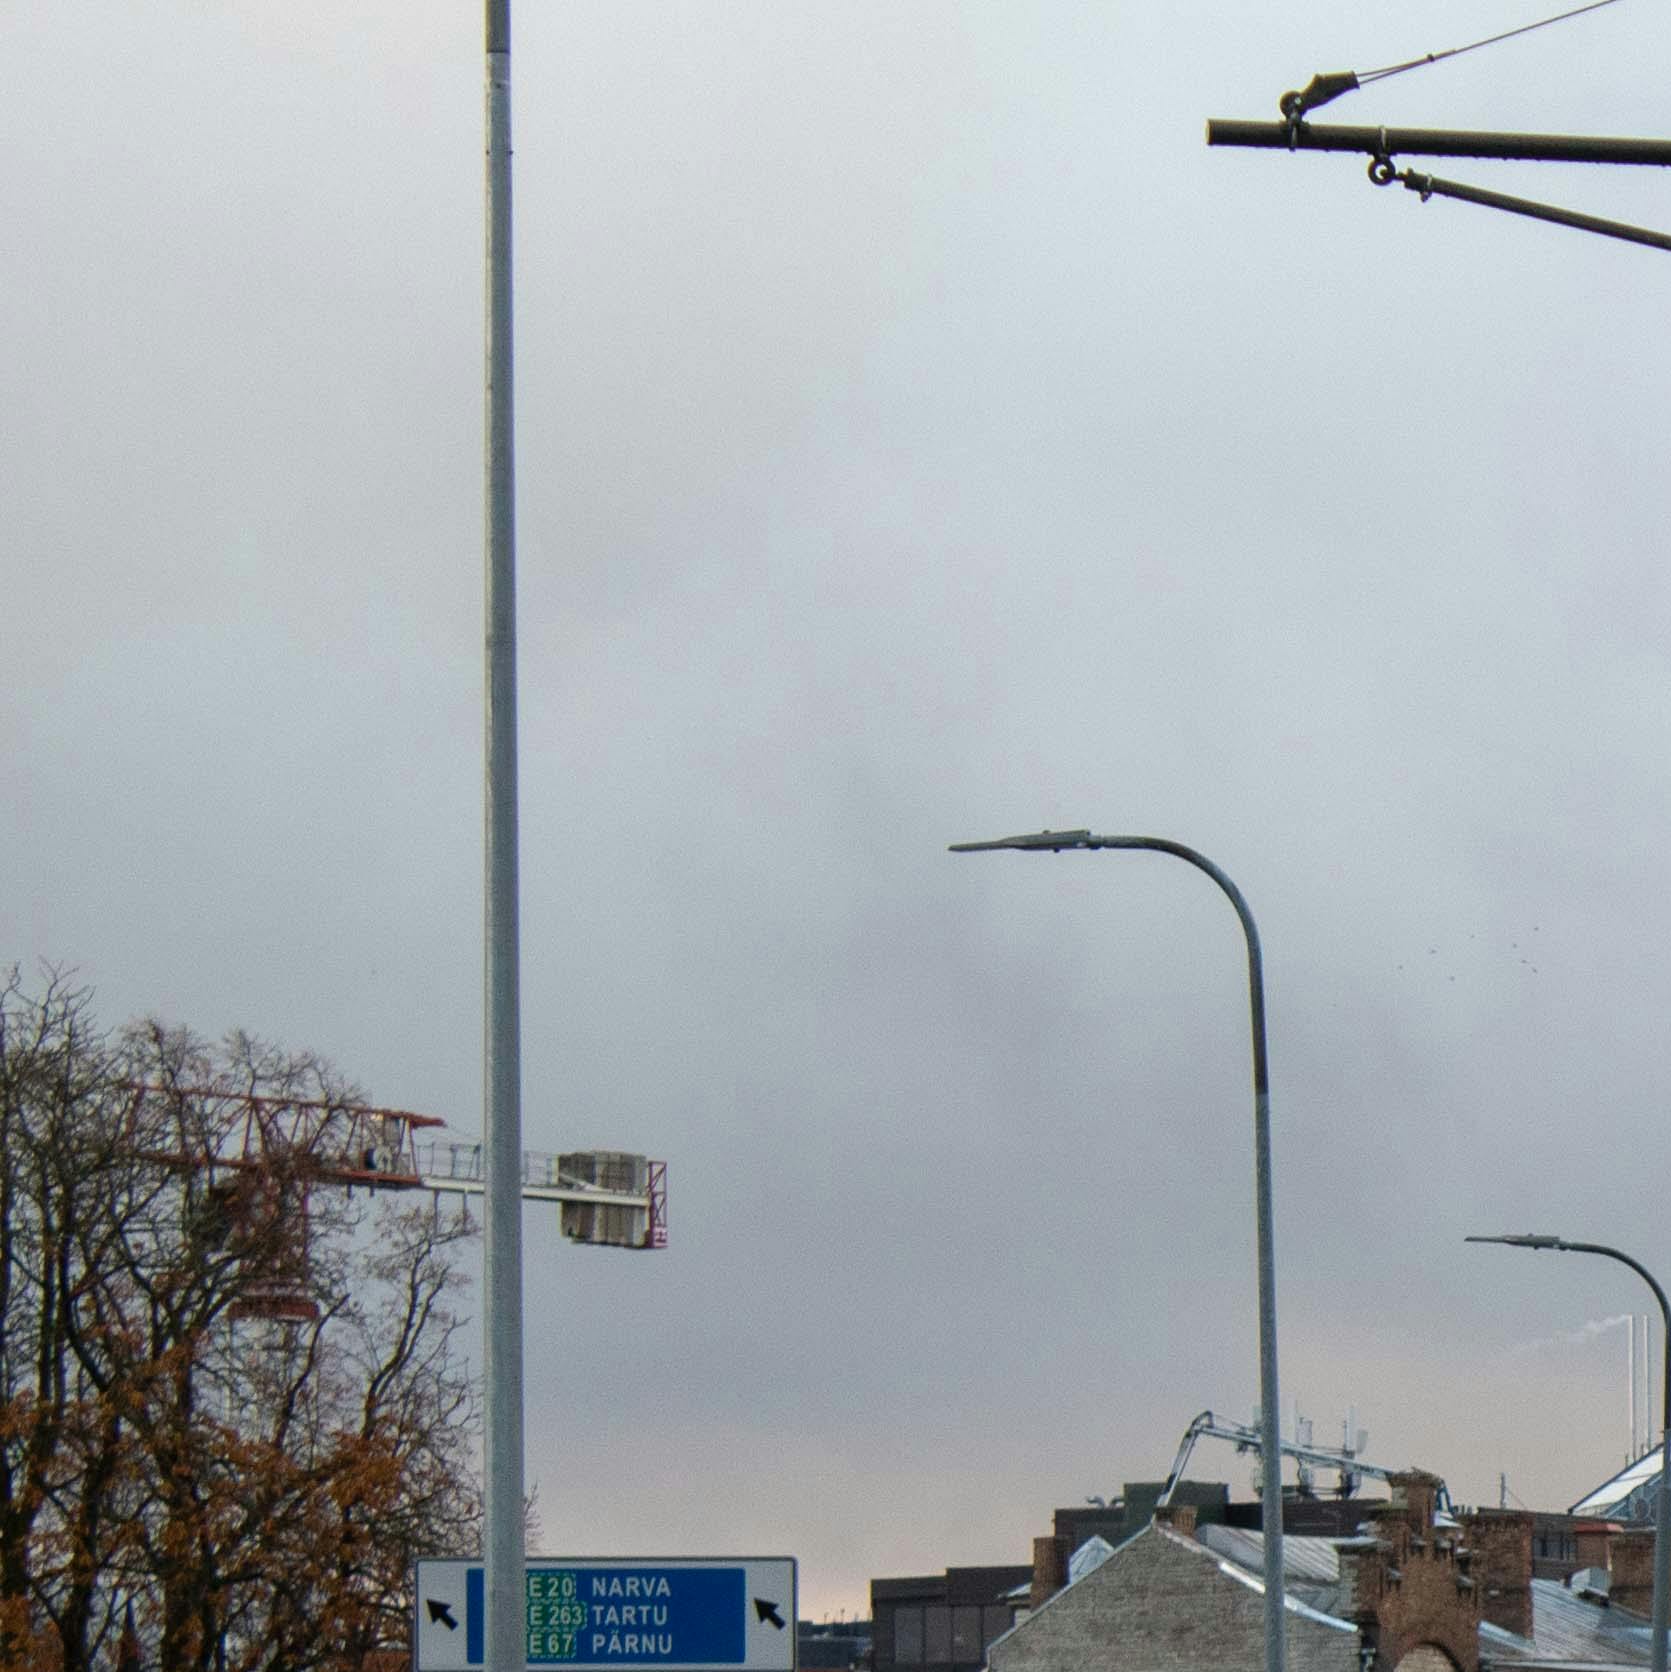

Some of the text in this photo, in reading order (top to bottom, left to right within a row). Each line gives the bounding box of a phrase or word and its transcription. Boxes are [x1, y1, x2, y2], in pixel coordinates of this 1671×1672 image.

[529, 1577, 672, 1598] E 20 NARVA
[530, 1605, 668, 1626] E 263 TARTU
[530, 1630, 673, 1655] E 67 PÄRNU
